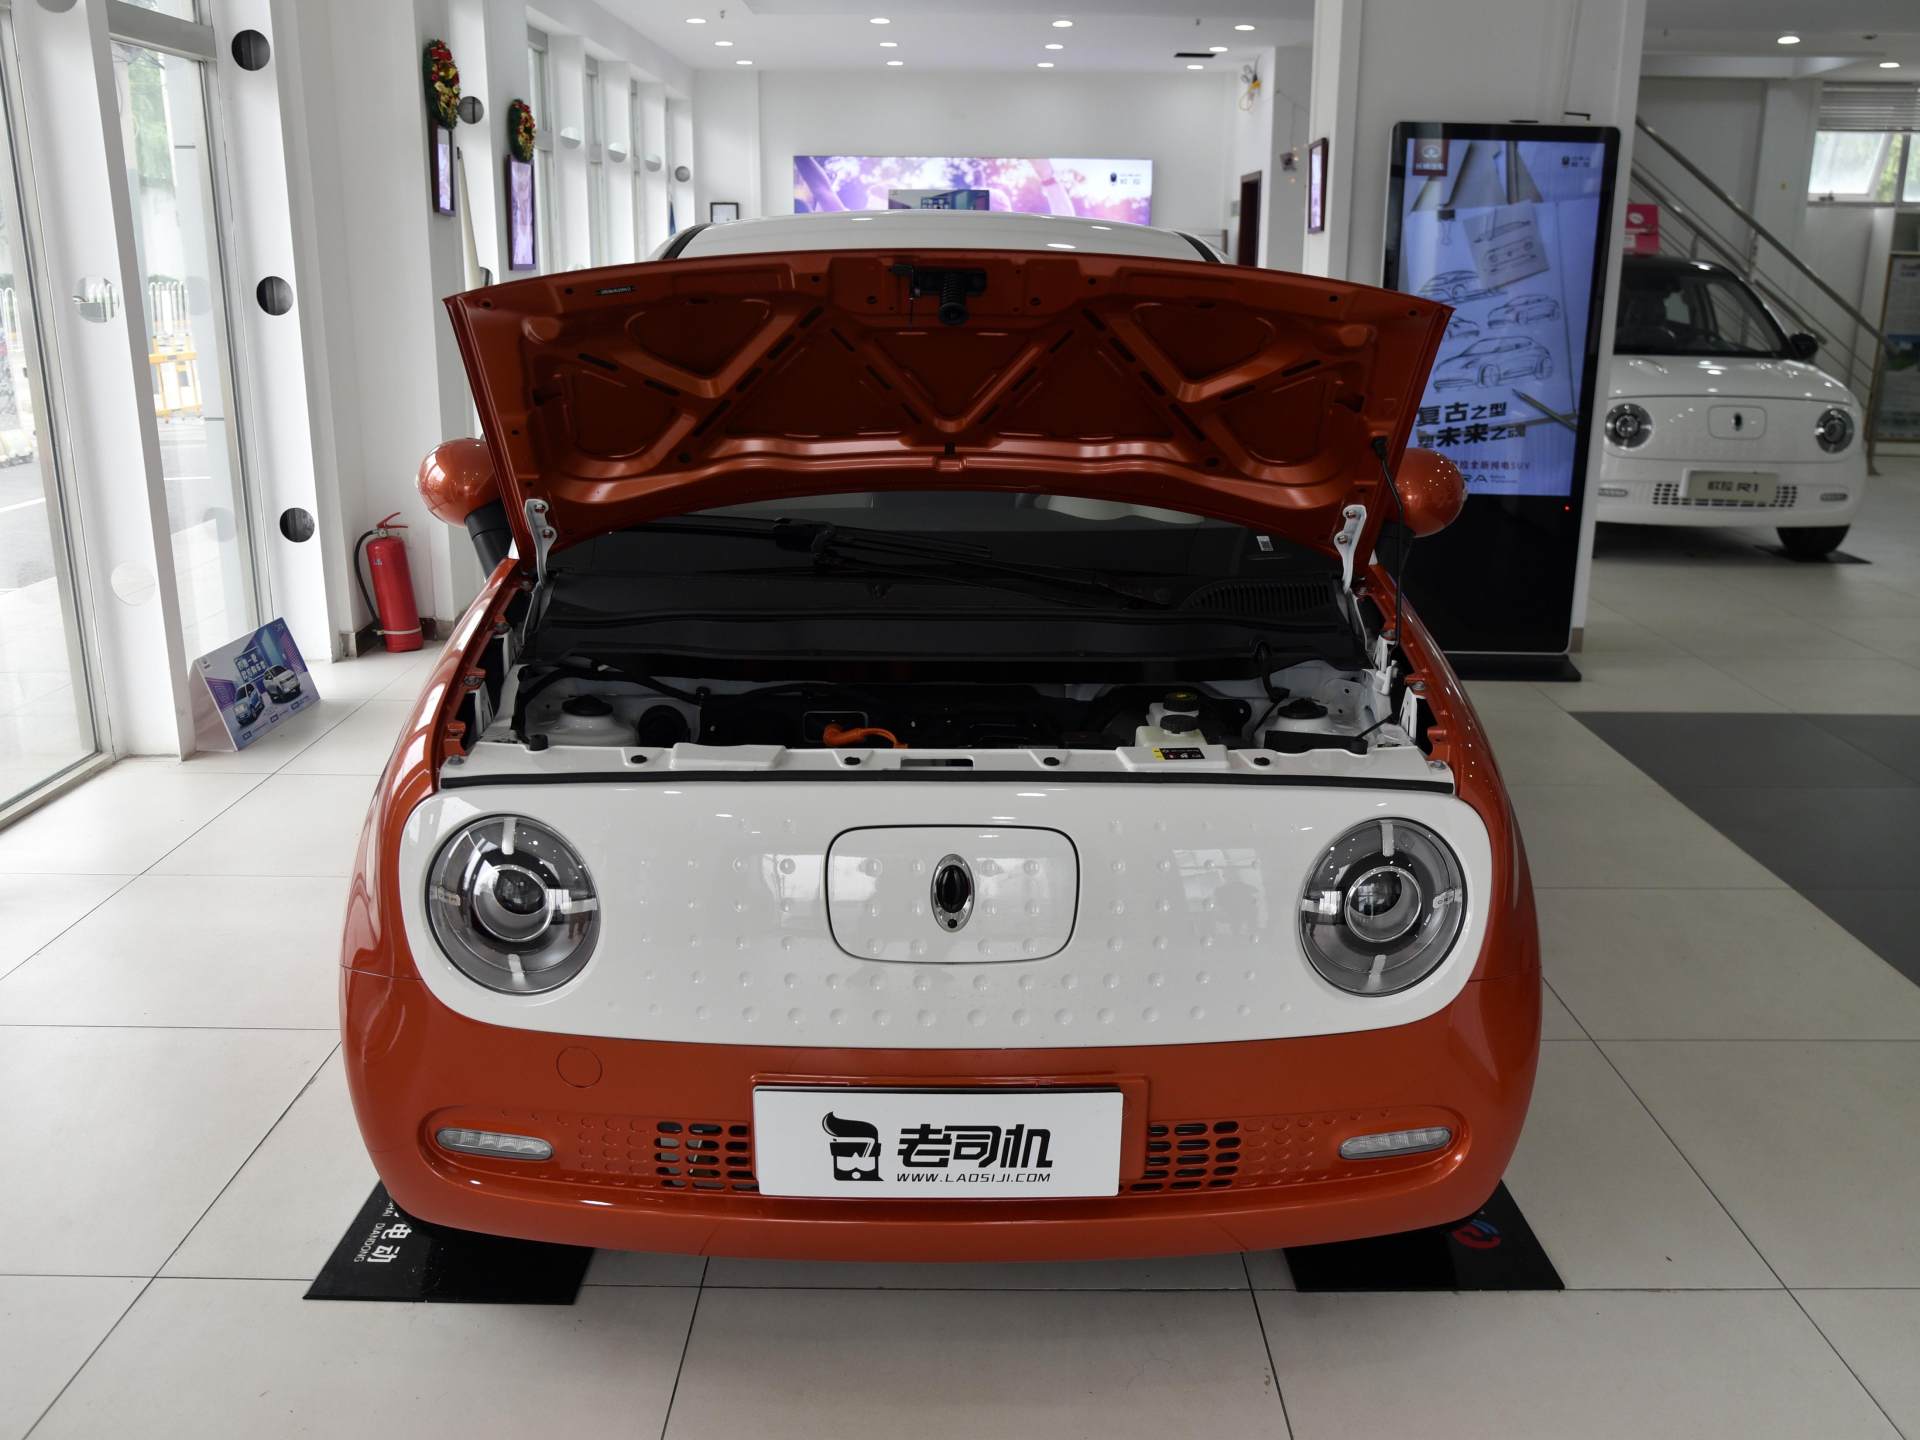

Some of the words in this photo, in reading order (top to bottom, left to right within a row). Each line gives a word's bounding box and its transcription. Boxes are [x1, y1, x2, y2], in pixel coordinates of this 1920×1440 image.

[897, 1123, 1053, 1168] 老司机
[896, 1173, 1051, 1183] WWW.LAOSIJI.COM
[367, 1223, 412, 1263] 电动
